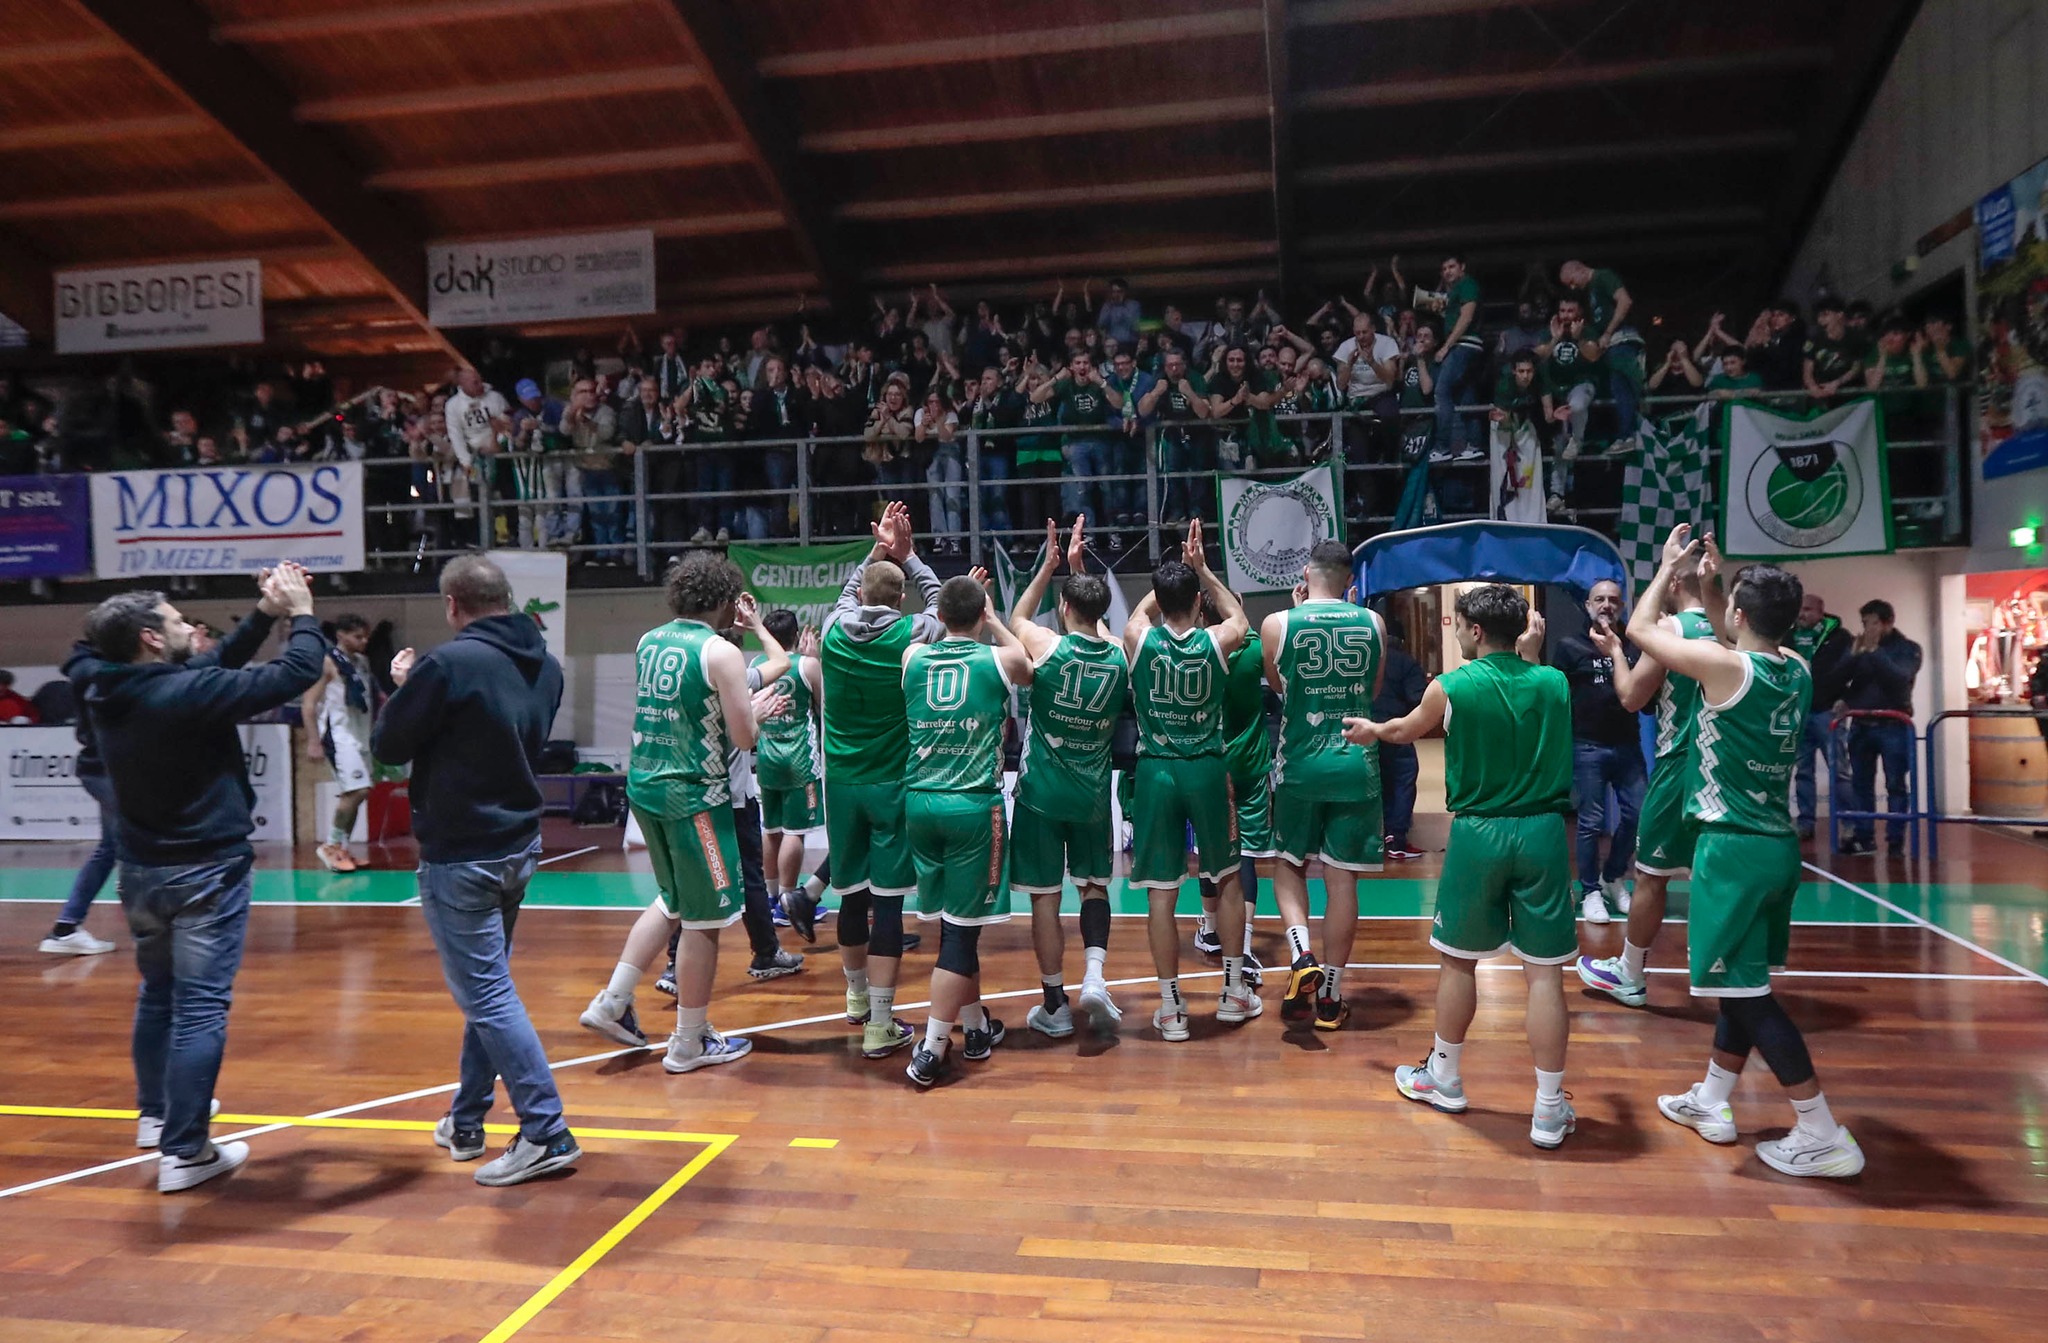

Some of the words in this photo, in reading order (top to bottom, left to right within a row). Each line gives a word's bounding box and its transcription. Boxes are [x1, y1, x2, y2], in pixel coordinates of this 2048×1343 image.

[500, 254, 565, 276] STUDIO
[1789, 453, 1820, 468] 1871
[110, 466, 343, 531] MIXOS
[152, 548, 236, 570] MIELE
[1293, 626, 1371, 679] 35
[638, 644, 687, 701] 18
[927, 659, 969, 711] 0
[1054, 659, 1119, 712] 17
[1150, 654, 1212, 706] 10
[1305, 685, 1347, 695] Carrefour
[917, 719, 956, 729] Carrefour
[1049, 709, 1094, 726] Carrefour
[1149, 709, 1188, 721] Carrefour
[1769, 691, 1800, 752] 4
